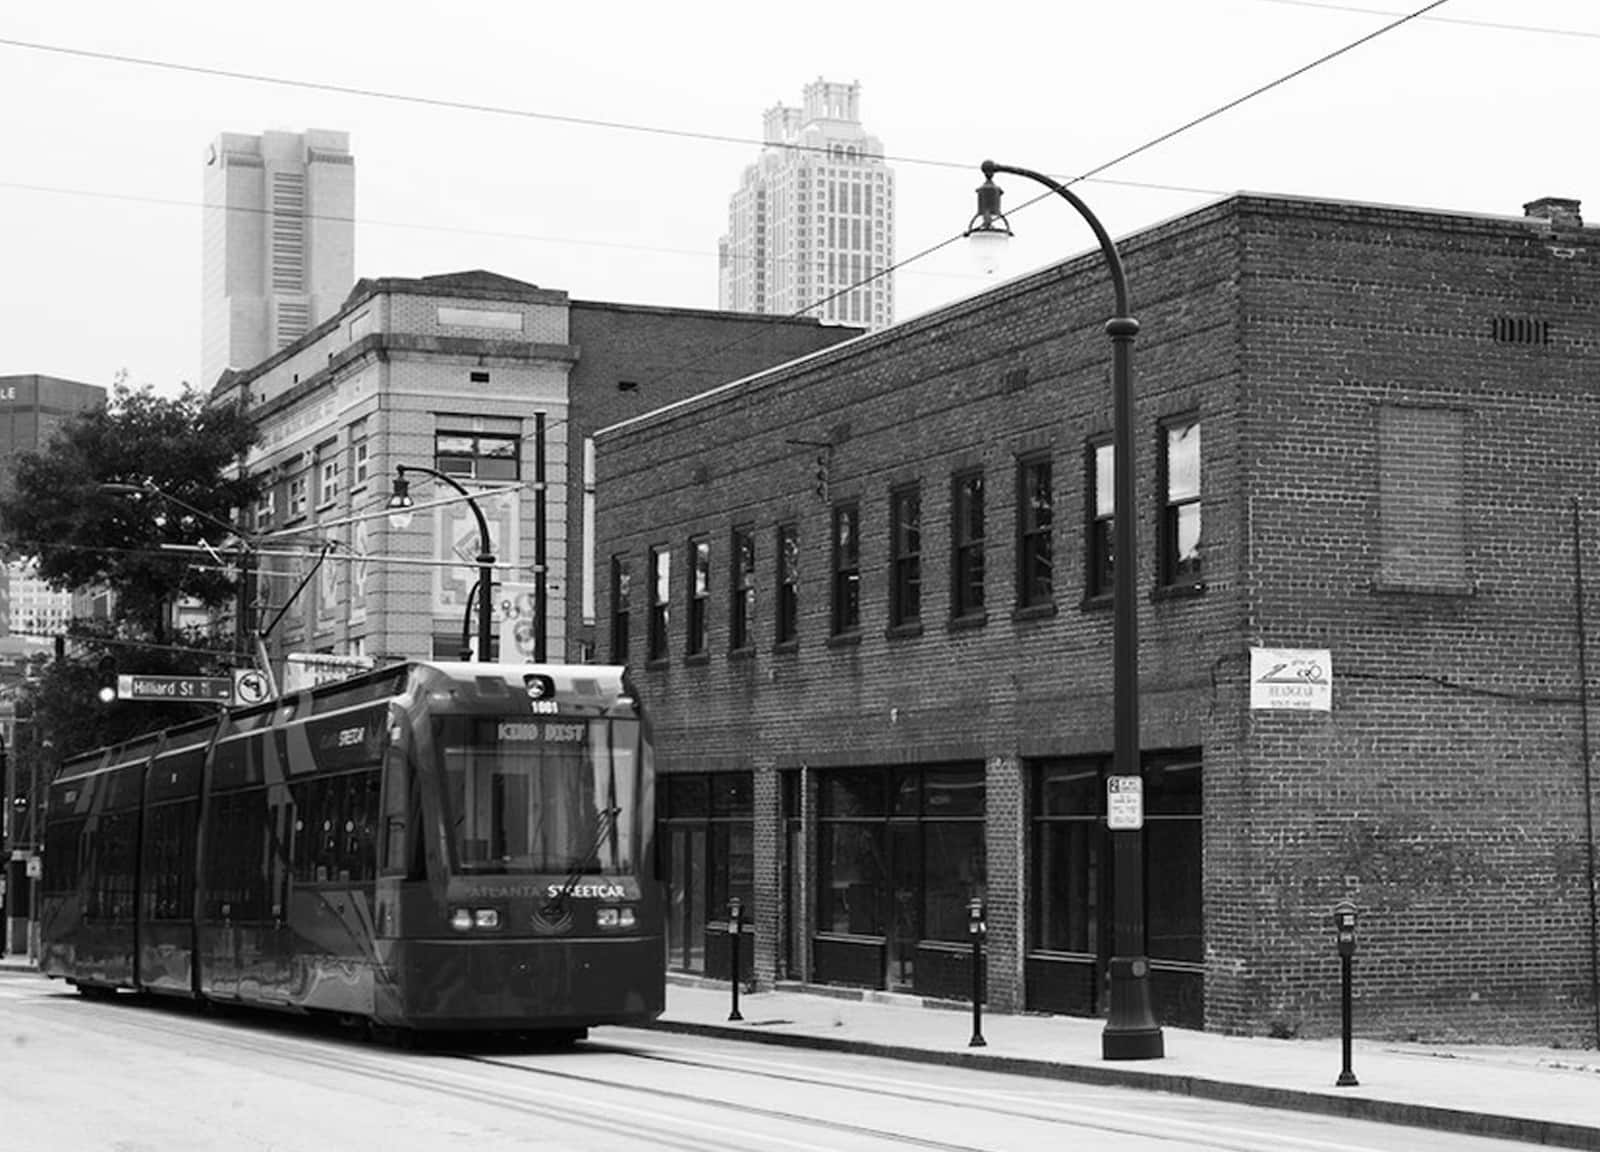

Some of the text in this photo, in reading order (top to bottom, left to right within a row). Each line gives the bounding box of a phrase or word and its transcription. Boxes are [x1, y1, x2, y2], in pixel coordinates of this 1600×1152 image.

[134, 679, 175, 696] Hilliard
[180, 681, 194, 696] St
[544, 723, 585, 741] DIST
